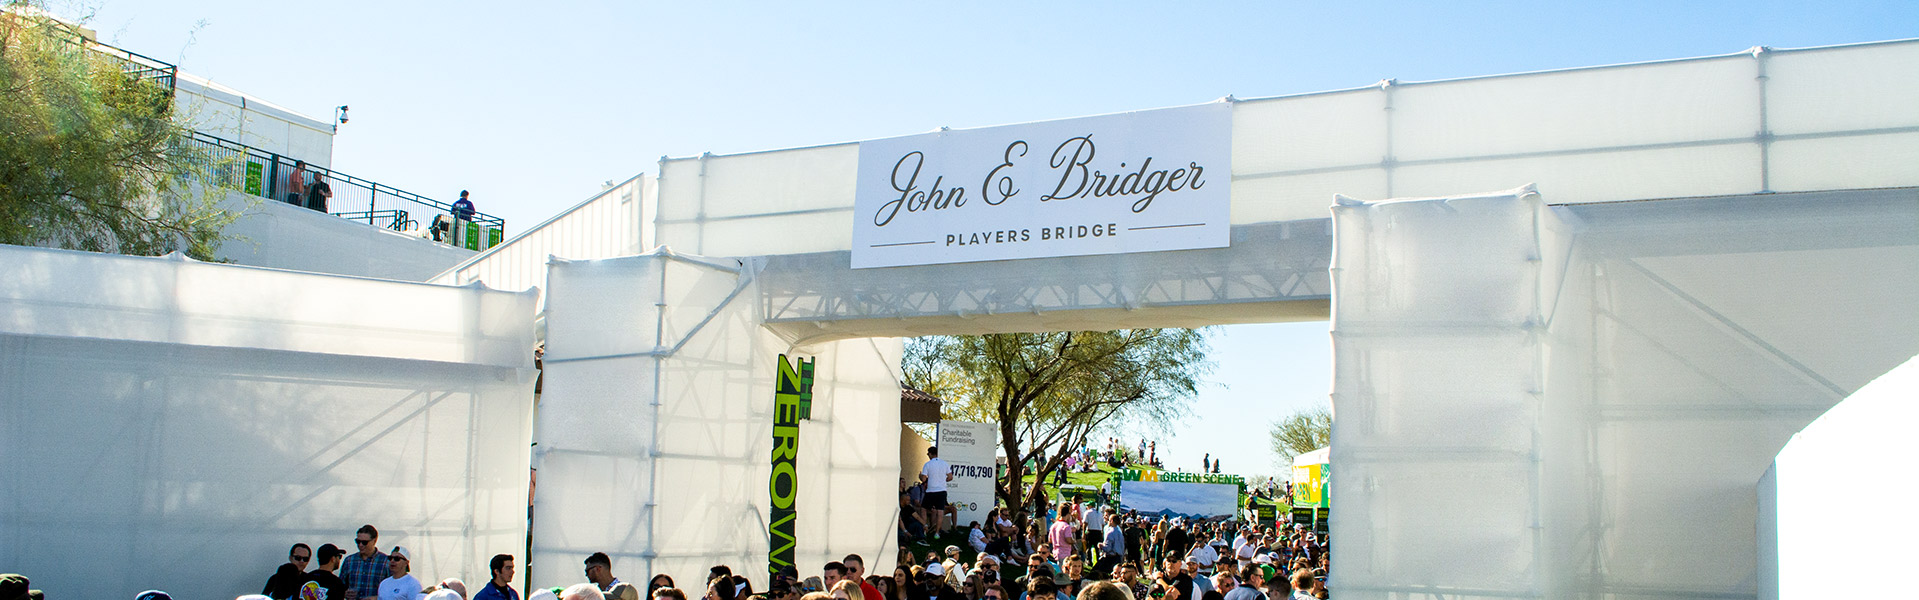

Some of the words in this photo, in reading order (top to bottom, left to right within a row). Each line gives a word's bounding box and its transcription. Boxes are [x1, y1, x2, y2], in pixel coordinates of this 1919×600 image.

[874, 150, 968, 227] John
[982, 140, 1028, 206] E
[1040, 133, 1206, 213] Bridger
[946, 229, 1030, 246] PLAYERS
[1041, 223, 1117, 240] BRIDGE
[800, 356, 815, 419] THE
[942, 428, 972, 437] Charitable
[942, 435, 975, 445] Fundraising
[1123, 469, 1158, 482] WM
[1162, 471, 1200, 483] GREEN
[1202, 474, 1239, 485] SCENE
